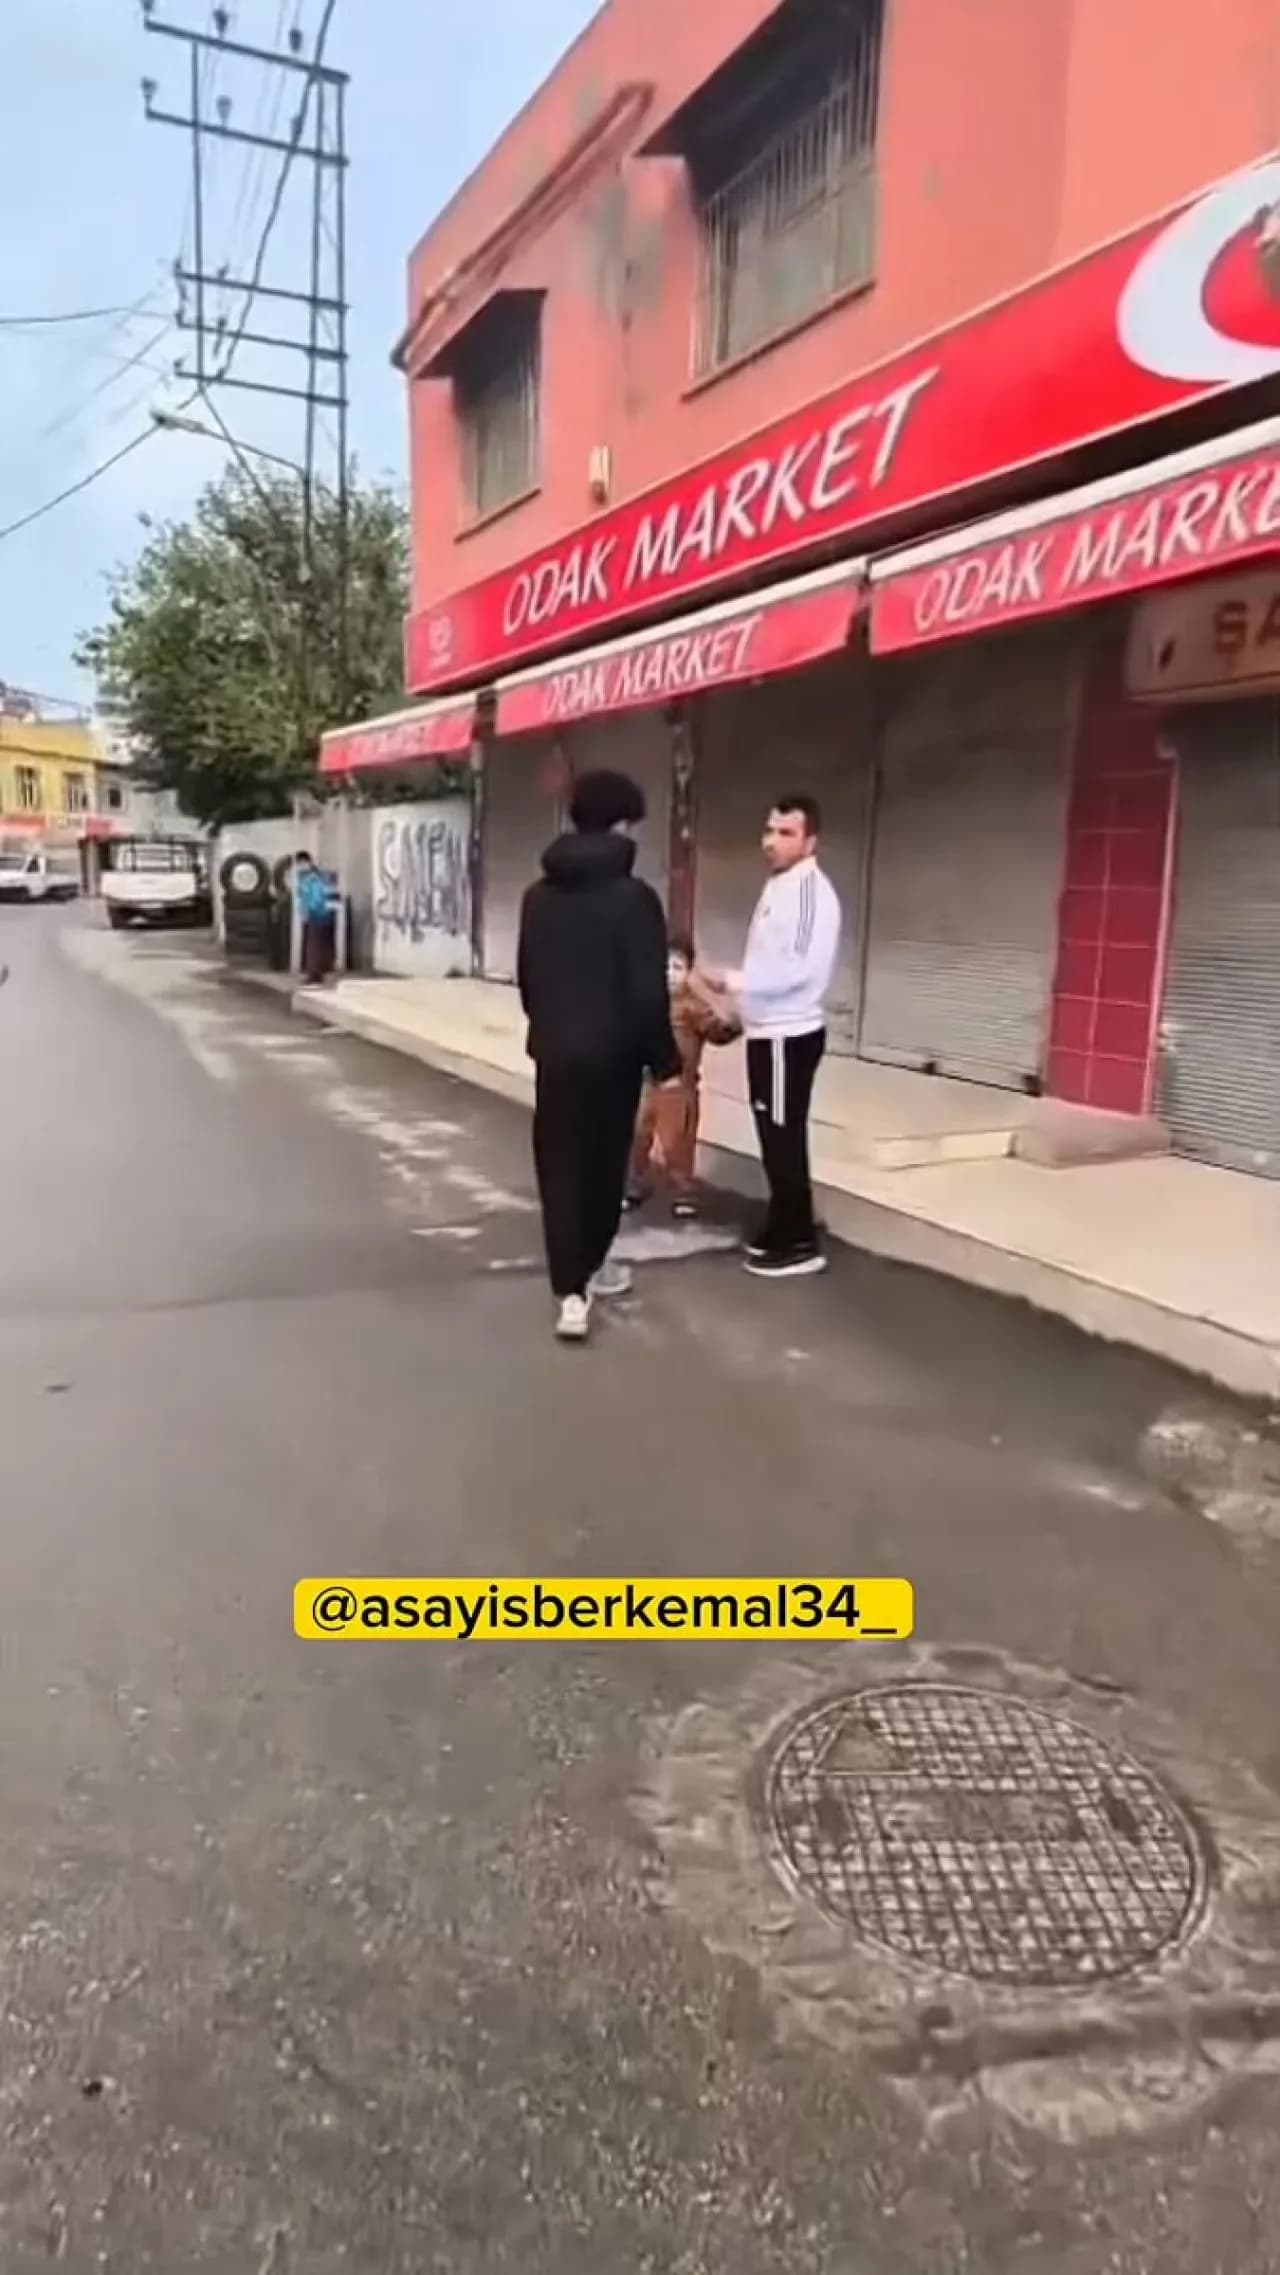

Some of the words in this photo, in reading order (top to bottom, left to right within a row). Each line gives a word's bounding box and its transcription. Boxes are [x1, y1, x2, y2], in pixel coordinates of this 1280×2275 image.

[503, 533, 619, 637] ODAK
[626, 365, 940, 585] MARKET
[914, 537, 1053, 631] ODAK
[541, 664, 607, 718] ODAK
[609, 613, 764, 700] MARKET
